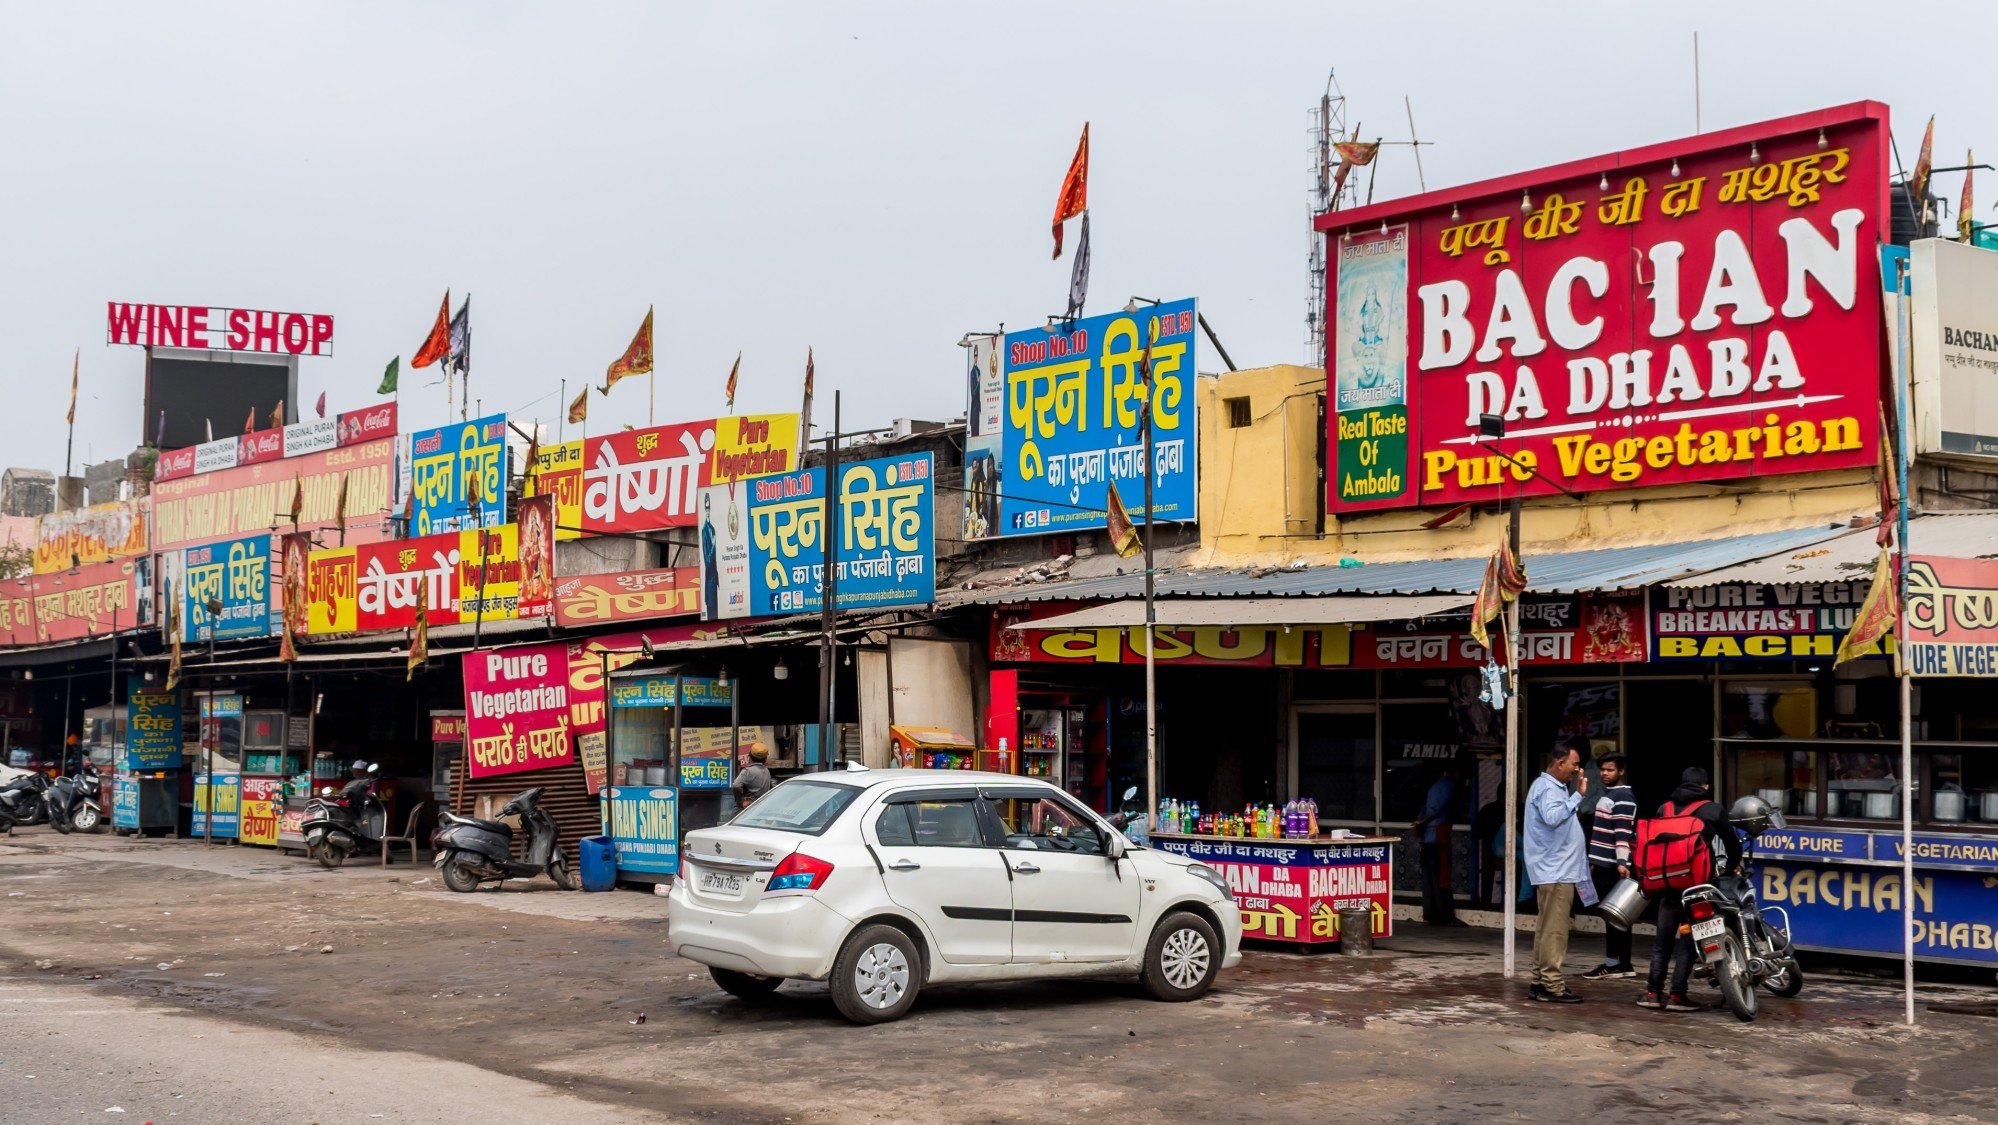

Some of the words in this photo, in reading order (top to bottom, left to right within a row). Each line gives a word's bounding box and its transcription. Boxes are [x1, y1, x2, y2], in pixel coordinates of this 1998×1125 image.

[1439, 216, 1512, 266] पप्पू
[1523, 193, 1587, 240] वीर
[1599, 177, 1650, 226] जी
[1660, 176, 1709, 217] दा
[1718, 148, 1850, 208] मशहूर
[1344, 245, 1363, 259] जय
[1366, 240, 1389, 255] माता
[1393, 232, 1406, 251] दी
[108, 302, 209, 347] WINE
[227, 309, 333, 356] SHOP
[1011, 340, 1046, 365] Shop
[1049, 329, 1087, 358] No.10
[1341, 390, 1360, 403] जय
[1361, 386, 1388, 401] माता
[1389, 378, 1401, 398] दी
[1466, 365, 1548, 427] DA
[1566, 330, 1806, 415] DHABA
[1008, 358, 1091, 481] पूरन
[1100, 316, 1186, 430] सिंह
[286, 424, 312, 440] ORIGINAL
[314, 421, 335, 434] PURAN
[364, 408, 391, 431] Coca-Cola
[738, 416, 769, 445] Pure
[1338, 415, 1368, 440] Real
[1369, 411, 1407, 437] Taste
[197, 446, 217, 459] ORIGINAL
[218, 442, 235, 454] PURAN
[258, 433, 280, 453] Coca-Cola
[286, 440, 303, 453] SINGH
[304, 438, 313, 449] KA
[314, 434, 335, 447] DHABA
[326, 450, 355, 466] Estd.
[360, 442, 390, 460] 1950
[553, 446, 567, 463] जी
[570, 448, 580, 460] दा
[636, 432, 659, 457] शुद्ध
[1360, 440, 1379, 466] Of
[1423, 443, 1538, 492] Pure
[1553, 413, 1863, 482] Vegetarian
[173, 452, 192, 471] Coca-Cola
[196, 458, 210, 470] SINGH
[218, 455, 235, 466] DHABA
[716, 446, 787, 480] Vegetarian
[1048, 454, 1066, 487] का
[1069, 449, 1106, 505] पुराना
[1109, 430, 1146, 480] पंजाब
[156, 474, 210, 496] Original
[413, 452, 456, 537] पूरन
[756, 479, 782, 501] Shop
[785, 472, 813, 496] No.10
[1343, 468, 1400, 497] Ambala
[277, 471, 339, 527] MAHOOR
[751, 496, 826, 590] पूरन
[840, 465, 924, 552] सिंह
[478, 530, 502, 557] Pure
[399, 548, 417, 572] शुद्ध
[792, 565, 810, 584] का
[812, 561, 847, 593] पुाना
[851, 549, 892, 579] पंजाबी
[187, 563, 224, 625] पूरन
[228, 541, 267, 601] सिंह
[462, 558, 519, 592] Vegtarian
[556, 578, 581, 596] आहुजा
[308, 555, 356, 627] आहुजा
[560, 578, 700, 619] वैष्ण
[1669, 585, 1765, 608] PURE
[13, 598, 30, 626] दा
[34, 592, 66, 640] पुराना
[1658, 609, 1814, 633] BREAKFAST
[1376, 635, 1451, 662] बचन
[1459, 634, 1496, 661] दा
[1910, 645, 1947, 674] URE
[487, 653, 548, 682] Pure
[130, 694, 176, 713] पूरन
[470, 684, 567, 719] Vegetarian
[613, 685, 642, 704] पूरन
[647, 680, 676, 698] सिंह
[682, 684, 706, 702] पूरन
[1135, 702, 1163, 713] pesi
[132, 714, 176, 731] सिंह
[435, 719, 453, 734] Pure
[516, 734, 528, 763] ही
[1402, 744, 1459, 758] FAMILY
[681, 765, 704, 785] पूरन
[707, 760, 729, 780] सिंह
[640, 799, 675, 840] SINGH
[1190, 841, 1212, 854] वीर
[1214, 841, 1233, 855] जी
[1236, 845, 1250, 856] दा
[1313, 849, 1329, 864] पप्पू
[1328, 845, 1341, 858] वीर
[1341, 845, 1352, 858] जी
[1353, 847, 1361, 857] दा
[1757, 835, 1795, 850] 100%
[1800, 837, 1843, 853] PURE
[1273, 866, 1290, 881] DA
[1309, 866, 1366, 897] BACHAN
[1372, 865, 1381, 879] DA
[1261, 882, 1302, 898] DHABA
[1365, 880, 1387, 895] DHABA
[1763, 867, 1934, 914] BACHAN
[1245, 896, 1270, 909] ढाबा
[1912, 919, 1998, 953] DHAB
